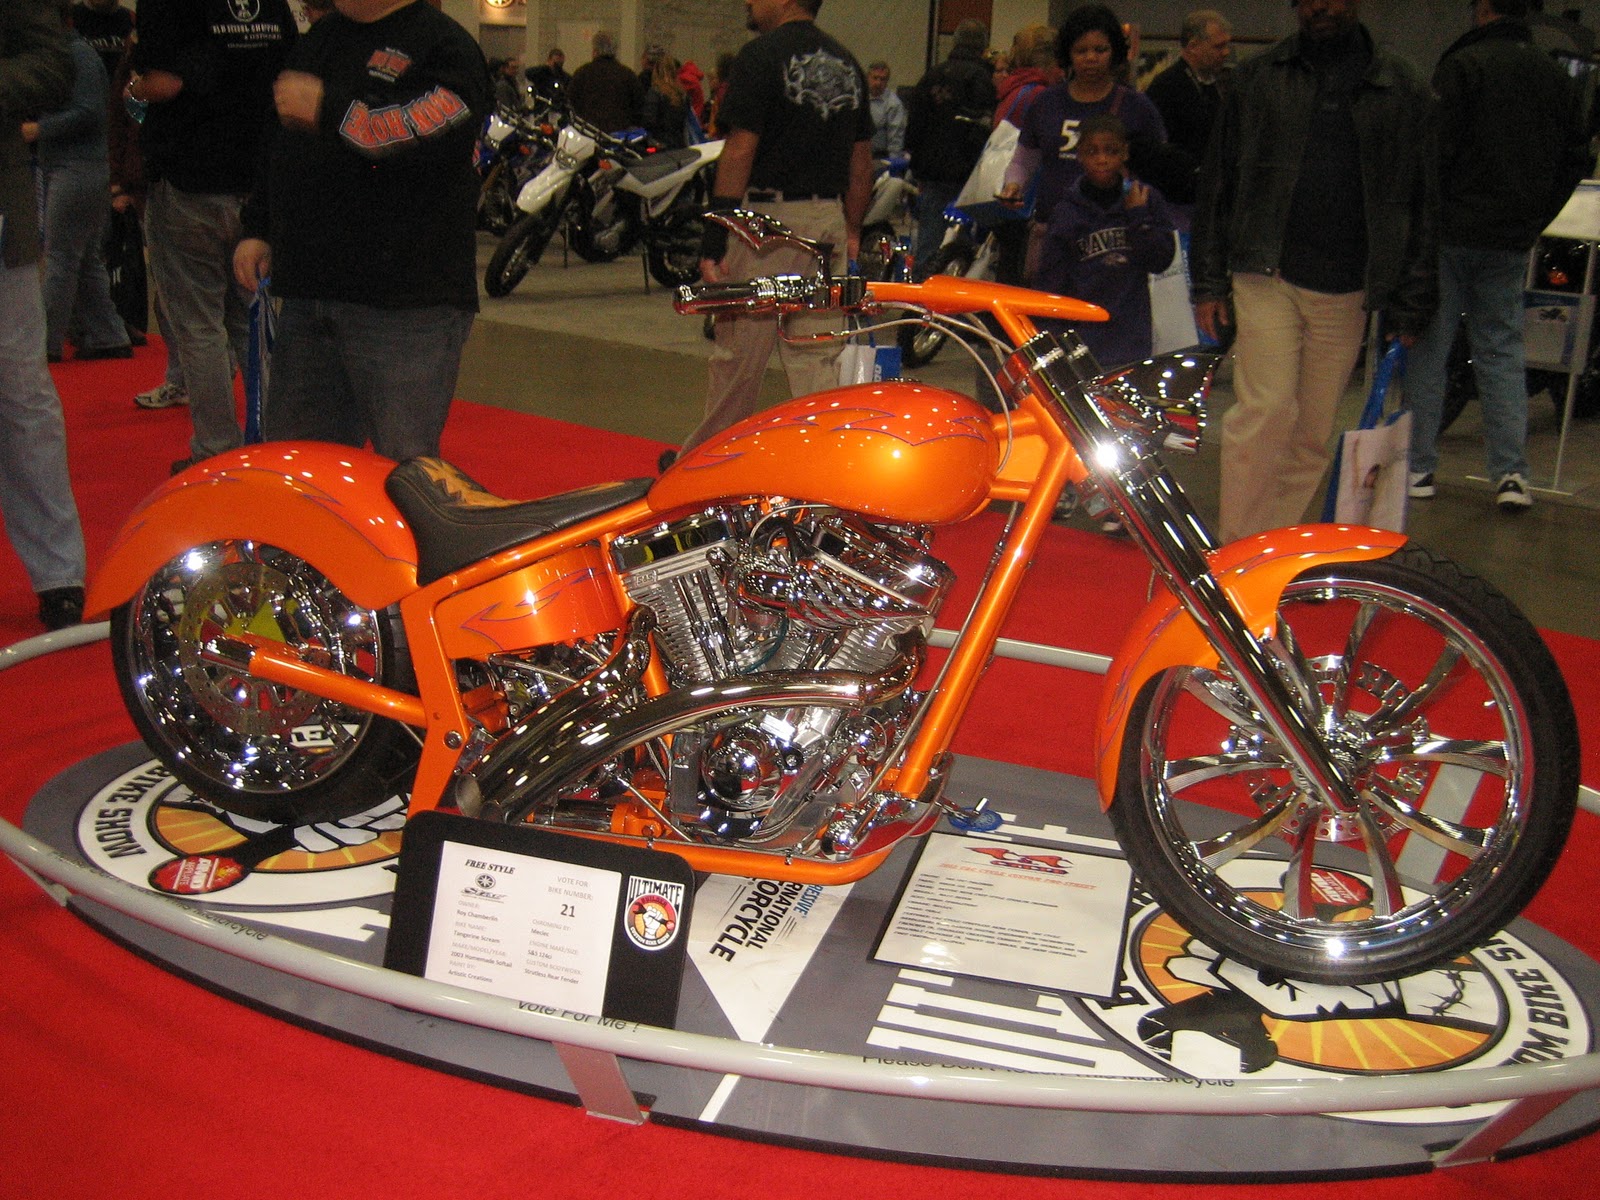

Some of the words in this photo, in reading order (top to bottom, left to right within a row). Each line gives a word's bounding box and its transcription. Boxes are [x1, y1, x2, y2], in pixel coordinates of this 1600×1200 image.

[95, 808, 148, 859] SHOW
[465, 859, 487, 870] FREE
[487, 863, 516, 875] STYLE
[557, 876, 575, 886] VOTE
[575, 879, 589, 888] FOR
[548, 886, 562, 895] BIKE
[563, 889, 594, 901] NUMBER:
[628, 877, 683, 912] ULTIMATE
[560, 903, 576, 918] 21
[532, 918, 562, 930] CHROMING
[454, 930, 480, 939] Tangerine
[481, 935, 501, 944] Scream
[495, 960, 513, 968] Softail
[467, 973, 493, 983] Creations
[560, 975, 579, 985] Fender
[1504, 968, 1570, 1030] BIKE
[518, 1000, 556, 1015] Vote
[560, 1009, 595, 1023] For
[597, 1016, 627, 1030] Me
